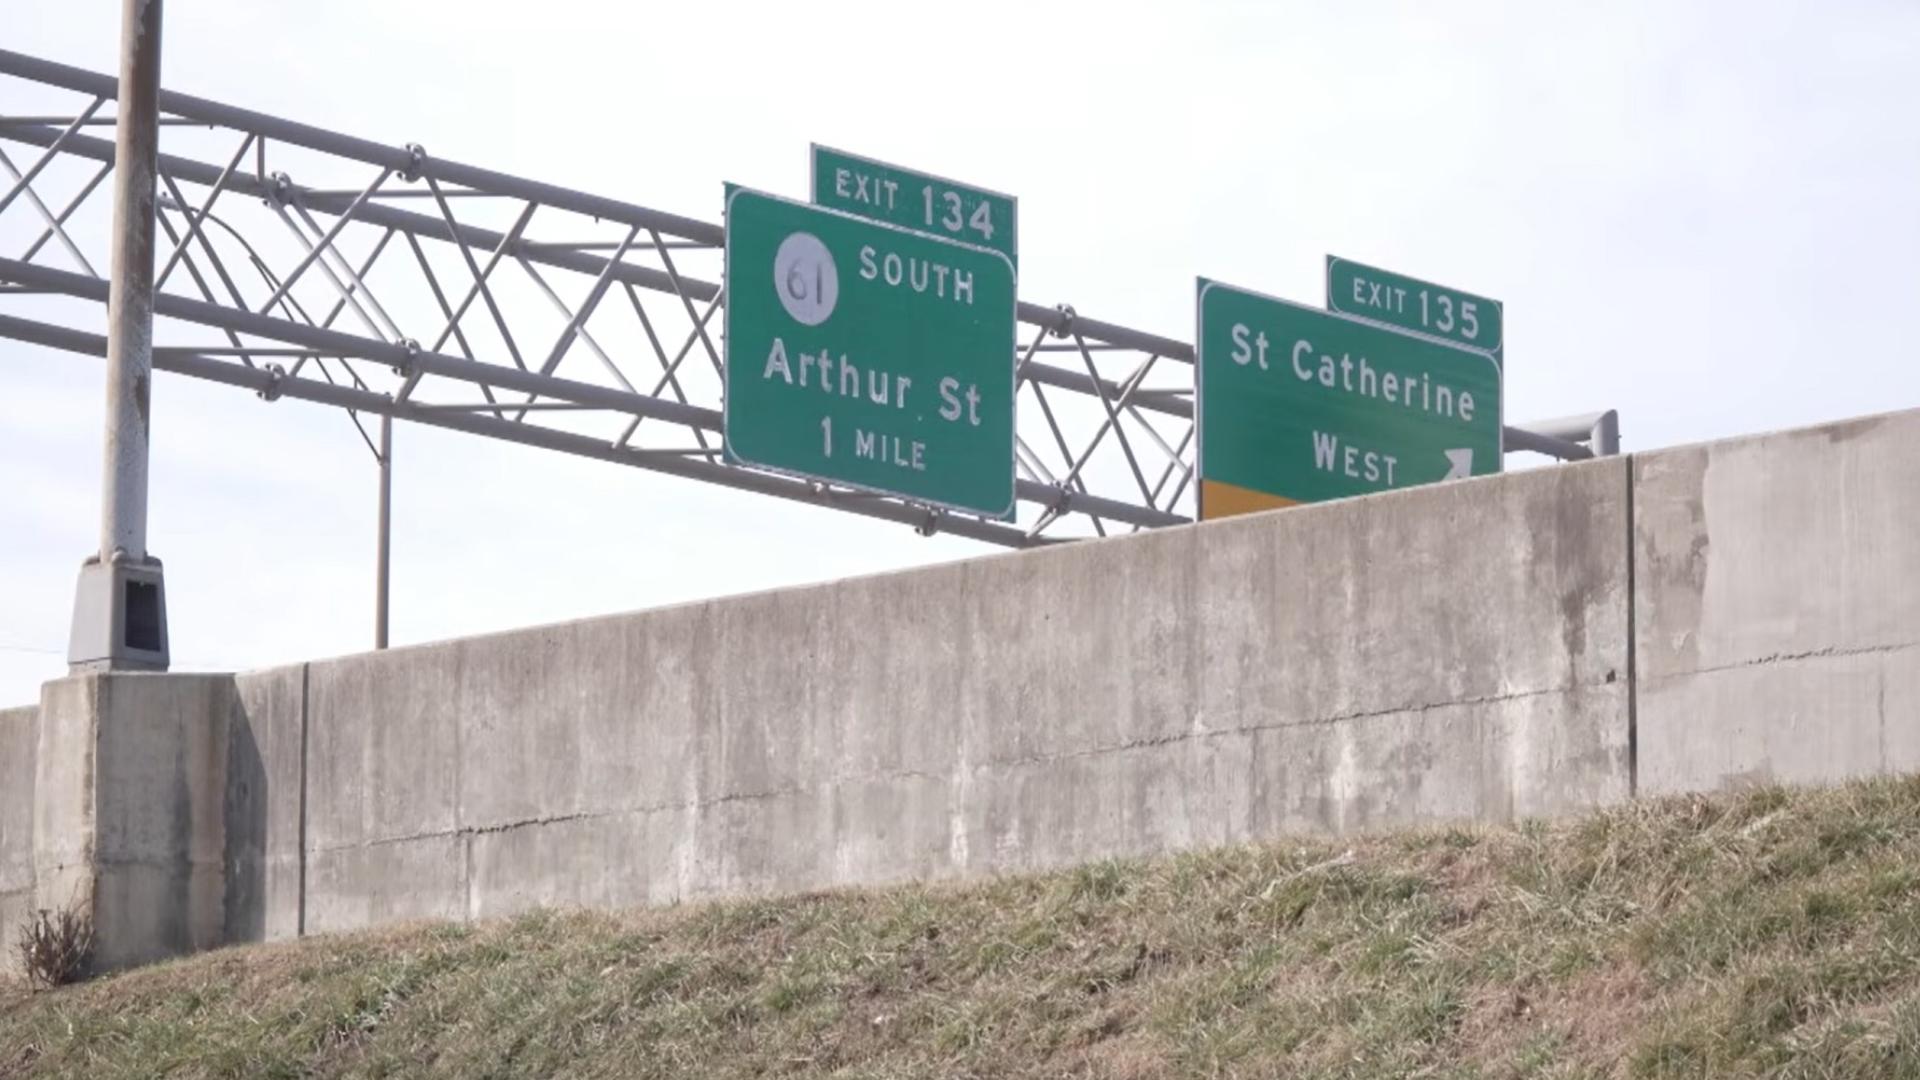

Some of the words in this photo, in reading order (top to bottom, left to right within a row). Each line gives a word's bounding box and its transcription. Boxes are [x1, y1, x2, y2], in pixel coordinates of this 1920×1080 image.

[836, 168, 899, 209] EXIT
[921, 185, 994, 240] 134
[786, 257, 823, 305] 61
[859, 245, 974, 305] SOUTH
[1352, 276, 1407, 313] EXIT
[1419, 289, 1480, 339] 135
[763, 337, 912, 409] Arthur
[938, 376, 982, 426] St
[1231, 322, 1269, 371] St
[1292, 339, 1475, 422] Catherine
[820, 416, 833, 458] 1
[855, 429, 927, 471] MILE
[1312, 430, 1399, 486] WEST
